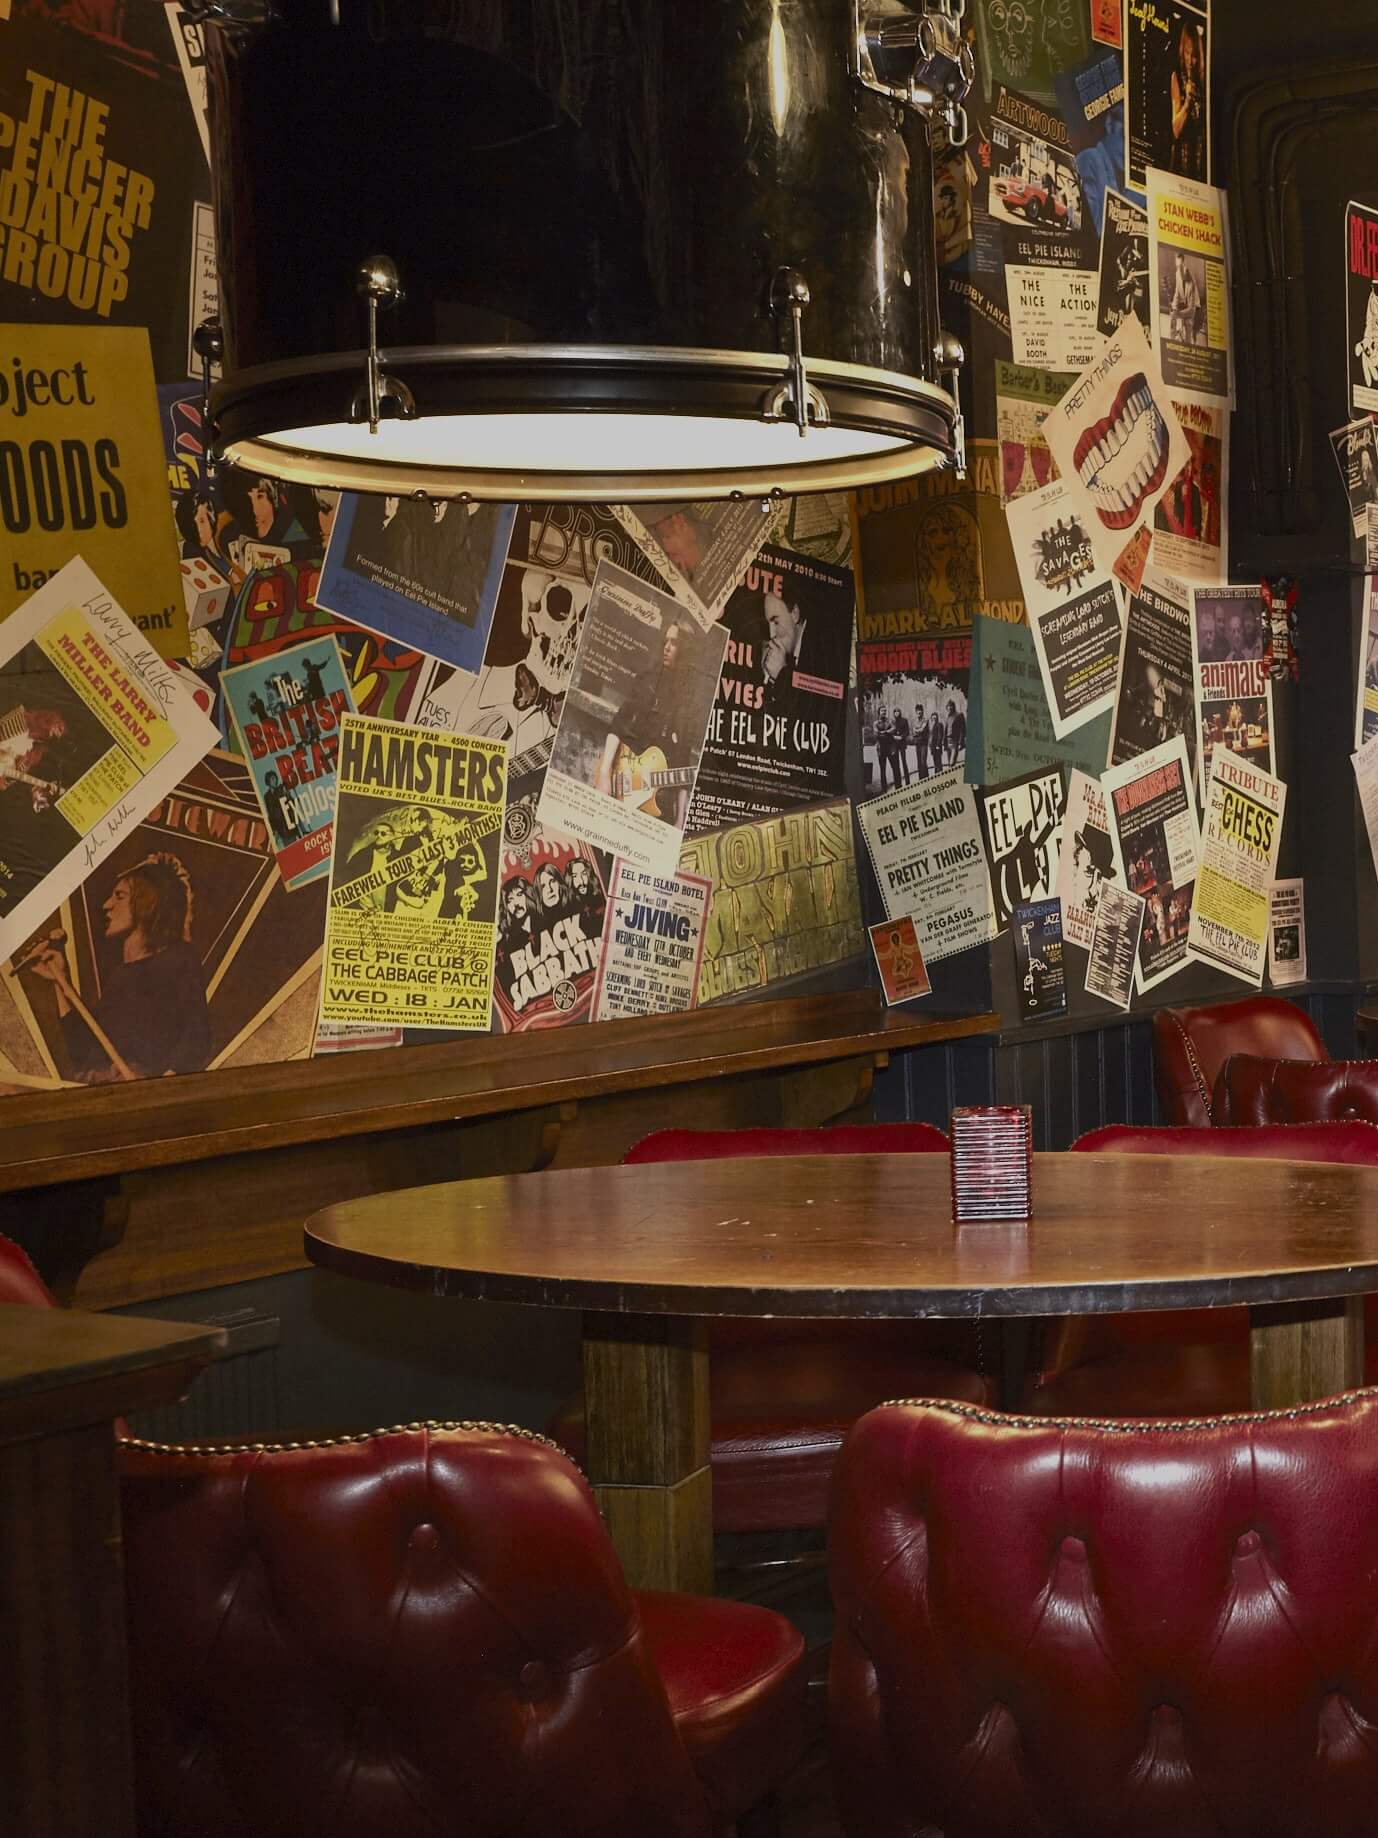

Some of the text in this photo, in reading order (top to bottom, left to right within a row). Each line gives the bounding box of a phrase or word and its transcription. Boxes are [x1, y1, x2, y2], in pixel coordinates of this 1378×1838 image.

[26, 69, 110, 158] THE
[0, 112, 155, 230] PENCER
[0, 168, 133, 272] DAVIS
[1164, 202, 1184, 218] STAN
[1186, 208, 1215, 227] WEBB'S
[1159, 218, 1194, 238] CHICKEN
[1195, 229, 1222, 247] SHACK
[1018, 243, 1081, 259] EEL PIE ISLAND
[1022, 280, 1042, 292] THE
[1069, 284, 1087, 296] THE
[986, 300, 1010, 328] HAYE
[1020, 296, 1045, 307] NICE
[1060, 299, 1097, 311] ACTION
[1026, 338, 1045, 347] DAVID
[1026, 350, 1047, 358] BOOTH
[1064, 343, 1122, 419] PRETTY THINGS
[1054, 535, 1072, 550] THE
[356, 554, 399, 580] Formed from
[774, 556, 814, 579] MAY 2010
[1042, 542, 1092, 576] SAVAGES
[57, 633, 112, 701] MILLER
[111, 699, 151, 747] BAND
[82, 632, 112, 670] THE
[109, 667, 156, 723] LARRY
[272, 673, 304, 707] The
[244, 689, 350, 760] BRITISH
[422, 700, 450, 724] TUES
[345, 719, 506, 753] 25TH ANNIVERSARY YEAR 4500 CONCERTS
[731, 711, 757, 745] EEL
[793, 720, 831, 754] CLUB
[275, 735, 339, 789] BEAT
[341, 729, 504, 804] HAMSTERS
[1219, 761, 1279, 802] TRIBUTE
[339, 783, 369, 793] VOTED
[395, 791, 417, 800] BEST
[478, 803, 502, 812] BAND
[696, 794, 716, 805] JOHN
[876, 803, 898, 816] PEACH
[924, 778, 957, 798] BLOSSOM
[146, 800, 271, 852] STEWAR
[877, 797, 965, 845] EEL PIE ISLAND
[989, 798, 1024, 853] EEL
[1222, 792, 1274, 852] CHESS
[304, 830, 329, 852] ROCK
[422, 813, 500, 863] LAST 3 MONTHS!
[1208, 822, 1271, 872] RECORDS
[887, 839, 980, 889] PRETTY THINGS
[333, 853, 415, 907] FAREWELL TOUR
[622, 869, 705, 900] EEL PIE ISLAND HOTEL
[624, 903, 691, 942] JIVING
[927, 907, 974, 933] PEGASUS
[1044, 913, 1060, 926] JAZZ
[1197, 915, 1233, 937] NOVEMBER
[510, 914, 588, 979] BLACK
[615, 929, 651, 951] WEDNESDAY
[669, 943, 694, 960] OCTOBER
[920, 935, 933, 944] VAN
[1200, 925, 1215, 946] THE
[331, 948, 488, 973] EEL PIE CLUB @
[510, 937, 600, 1011] SABBATH
[637, 950, 651, 962] EVERY
[655, 954, 681, 969] WEDNESDAY
[331, 962, 488, 988] THE CABBAGE PATCH
[606, 984, 621, 993] CLIFF
[323, 1006, 487, 1020] www.thehamsters.co.uk
[330, 987, 487, 1011] WED 18 JAN
[322, 1014, 487, 1028] www.youtube.com/user/TheHamstersUK
